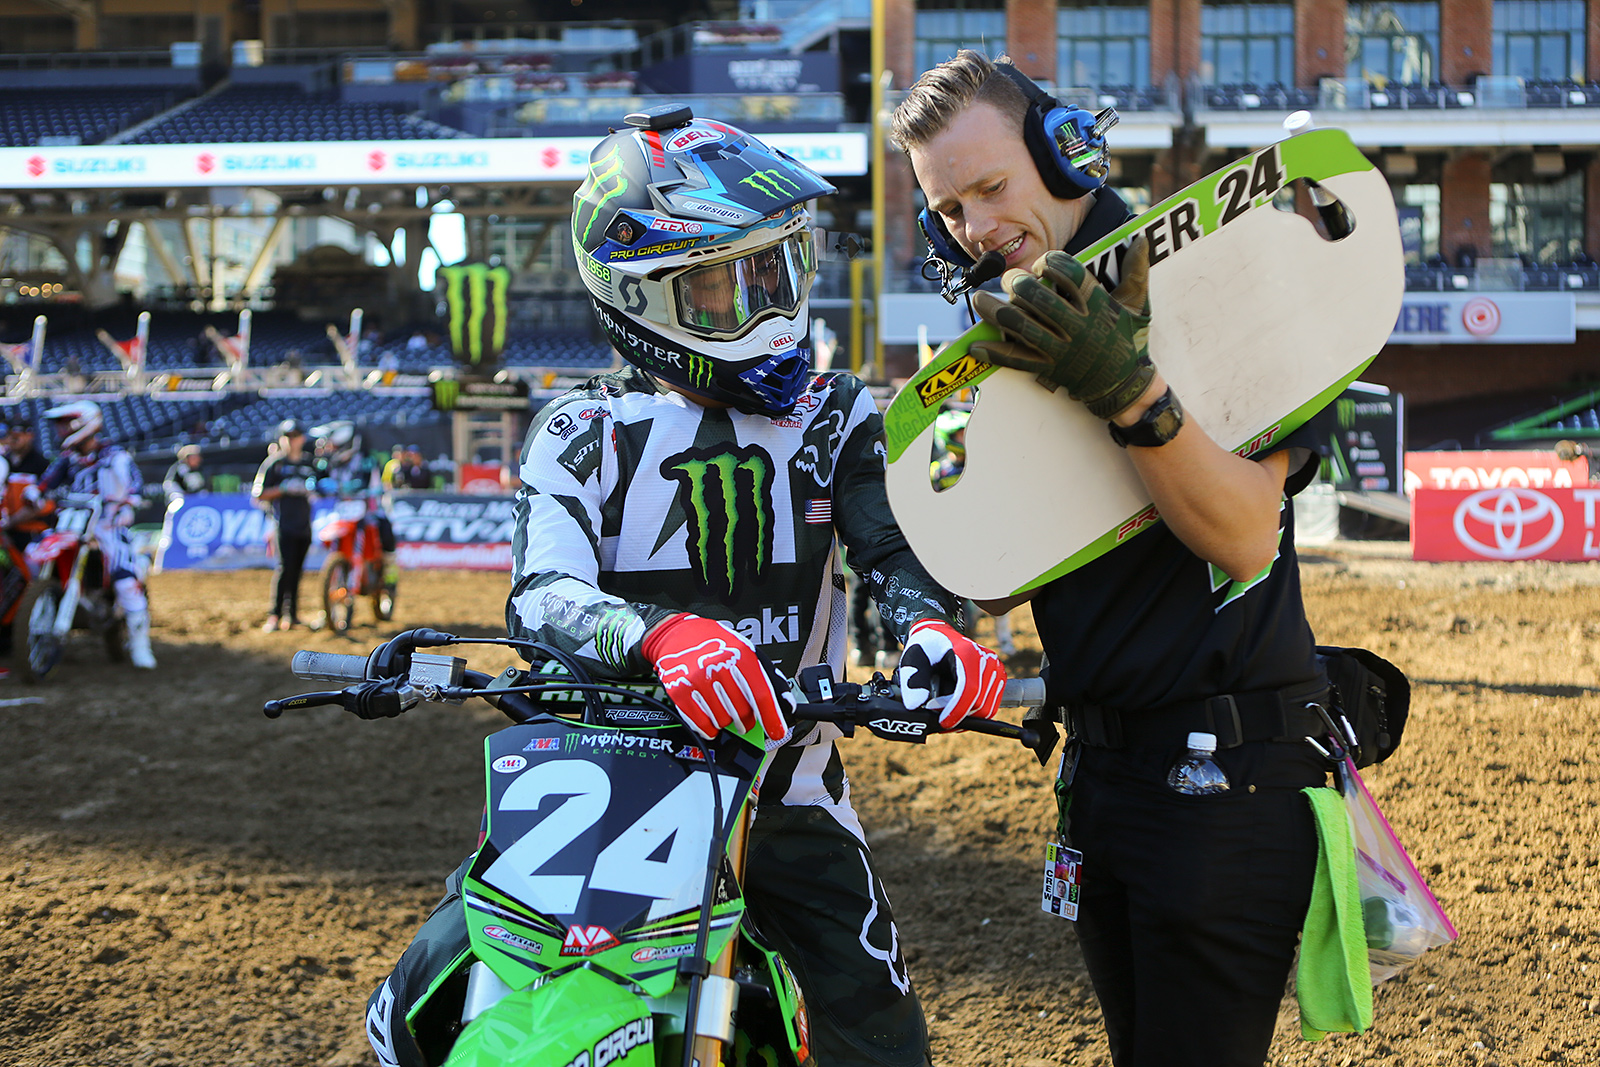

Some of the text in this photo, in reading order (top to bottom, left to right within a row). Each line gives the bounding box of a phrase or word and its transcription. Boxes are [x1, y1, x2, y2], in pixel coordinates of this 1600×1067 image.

[673, 130, 718, 148] BELL
[54, 157, 145, 174] SUZUKI
[224, 154, 316, 171] SUZUKI
[395, 153, 489, 168] SUZUKI
[1217, 145, 1283, 227] 24
[610, 237, 700, 259] PRO CIRCUIT
[586, 256, 611, 281] 1958
[773, 335, 794, 348] BELL
[924, 377, 966, 407] MECHANIX
[1430, 467, 1573, 488] TOYOTA
[544, 613, 584, 636] ENERGY
[869, 718, 927, 735] ARC
[523, 737, 560, 752] AMA
[581, 732, 674, 753] MONSTER
[592, 748, 659, 759] ENERGY
[480, 759, 740, 922] 24
[1043, 869, 1054, 901] CREW
